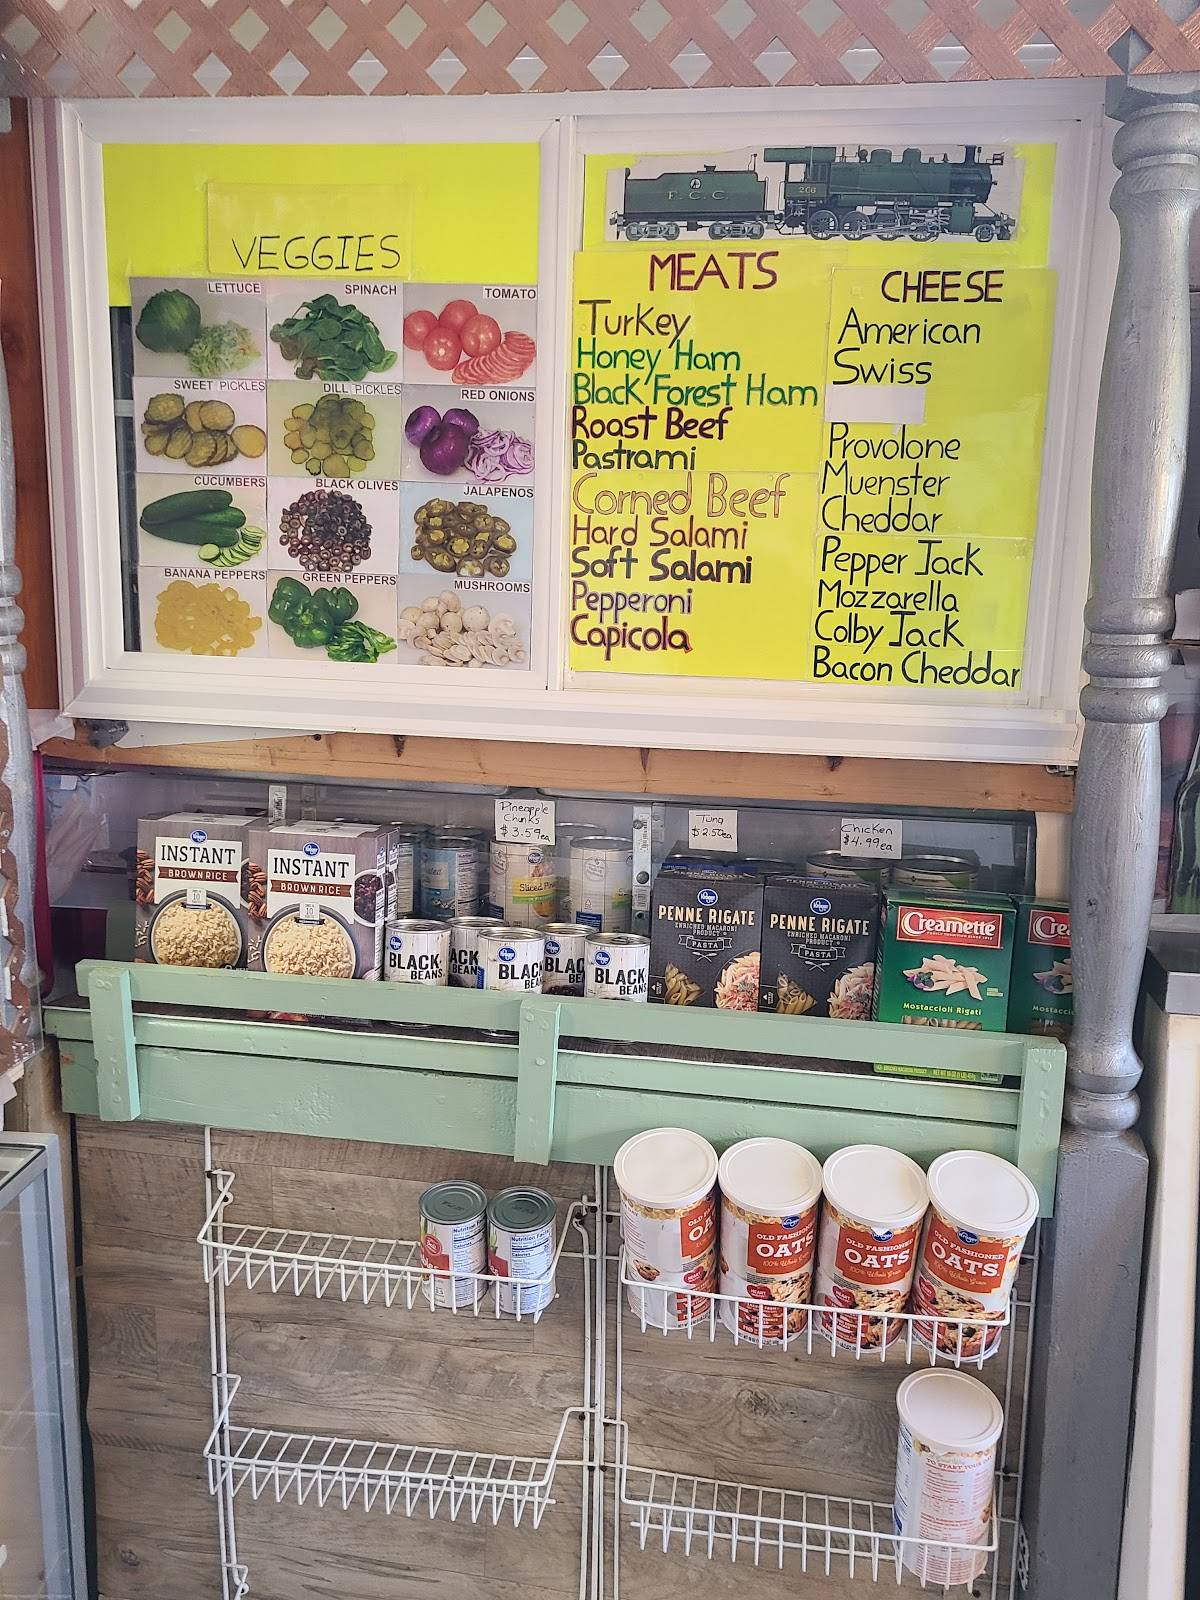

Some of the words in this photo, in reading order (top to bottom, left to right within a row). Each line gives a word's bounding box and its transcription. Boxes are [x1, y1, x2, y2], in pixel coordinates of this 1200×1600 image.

[232, 235, 401, 272] VEGGIES
[648, 251, 779, 291] MEATS
[207, 282, 261, 295] LETTUCE
[344, 283, 397, 297] SPINACH
[485, 287, 537, 300] TOMATO
[881, 270, 1005, 303] CHEESE
[579, 299, 692, 349] Turkey
[837, 307, 981, 345] American
[577, 337, 662, 386] Honey
[674, 339, 741, 372] Ham
[833, 347, 933, 385] Swiss
[174, 380, 213, 391] SWEET
[220, 381, 266, 392] PICKLES
[323, 383, 349, 394] DILL
[355, 384, 401, 396] PICKLES
[461, 389, 486, 401] RED
[489, 390, 535, 402] ONIONS
[574, 372, 645, 407] Black
[653, 373, 738, 407] Forest
[746, 373, 819, 407] Ham
[571, 405, 658, 440] Roast
[665, 406, 733, 440] Beef
[829, 422, 961, 460] Provolone
[572, 439, 697, 471] Pastrami
[194, 476, 266, 488] CUCUMBERS
[315, 478, 354, 490] BLACK
[356, 480, 399, 491] OLIVES
[821, 460, 951, 497] Muenster
[463, 486, 534, 499] JALAPENOS
[572, 471, 693, 515] Corned
[707, 472, 791, 518] Beef
[822, 495, 943, 533] Cheddar
[573, 514, 639, 545] Hard
[650, 514, 749, 549] Salami
[571, 545, 639, 579] Soft
[649, 548, 753, 584] Salami
[821, 535, 909, 586] Pepper
[915, 540, 983, 577] Jack
[164, 568, 211, 580] BANANA
[214, 569, 266, 581] PEPPERS
[302, 571, 341, 584] GREEN
[344, 574, 397, 587] PEPPERS
[454, 580, 531, 594] MUSHROOMS
[818, 579, 960, 613] Mozzarella
[572, 580, 693, 623] Pepperoni
[570, 613, 694, 661] Capicola
[815, 610, 885, 655] Colby
[889, 610, 965, 648] Jack
[813, 645, 893, 682] Bacon
[901, 650, 1020, 687] Cheddar
[499, 801, 549, 817] Pineapple
[696, 814, 724, 825] Tuna
[841, 823, 893, 835] Chicken
[161, 845, 236, 865] INSTANT
[169, 869, 203, 880] BROWN
[205, 871, 228, 881] RICE
[273, 857, 350, 878] INSTANT
[280, 882, 316, 893] BROWN
[318, 885, 341, 895] RICE
[658, 904, 703, 923] PENNE
[708, 908, 756, 926] RIGATE
[770, 913, 816, 932] PENNE
[821, 917, 870, 936] RIGATE
[902, 911, 997, 937] Creamette
[691, 940, 719, 949] PASTA
[804, 949, 832, 958] PASTA
[389, 951, 440, 970] BLACK
[449, 948, 479, 966] ACK
[545, 956, 585, 974] BLAC
[410, 968, 443, 980] BEANS
[452, 964, 479, 976] BEAN
[594, 967, 646, 985] BLACK
[619, 982, 647, 995] BEANS
[903, 1002, 953, 1014] Mostaccioli
[956, 1007, 982, 1016] Rigati
[1032, 1004, 1073, 1015] Mostacci
[688, 1215, 703, 1226] OLD
[689, 1216, 713, 1241] OA
[756, 1233, 775, 1241] OLD
[756, 1230, 814, 1258] OATS
[846, 1237, 864, 1249] OLD
[934, 1229, 949, 1245] OLD
[949, 1241, 1005, 1260] FASHIONED
[844, 1248, 910, 1269] OATS
